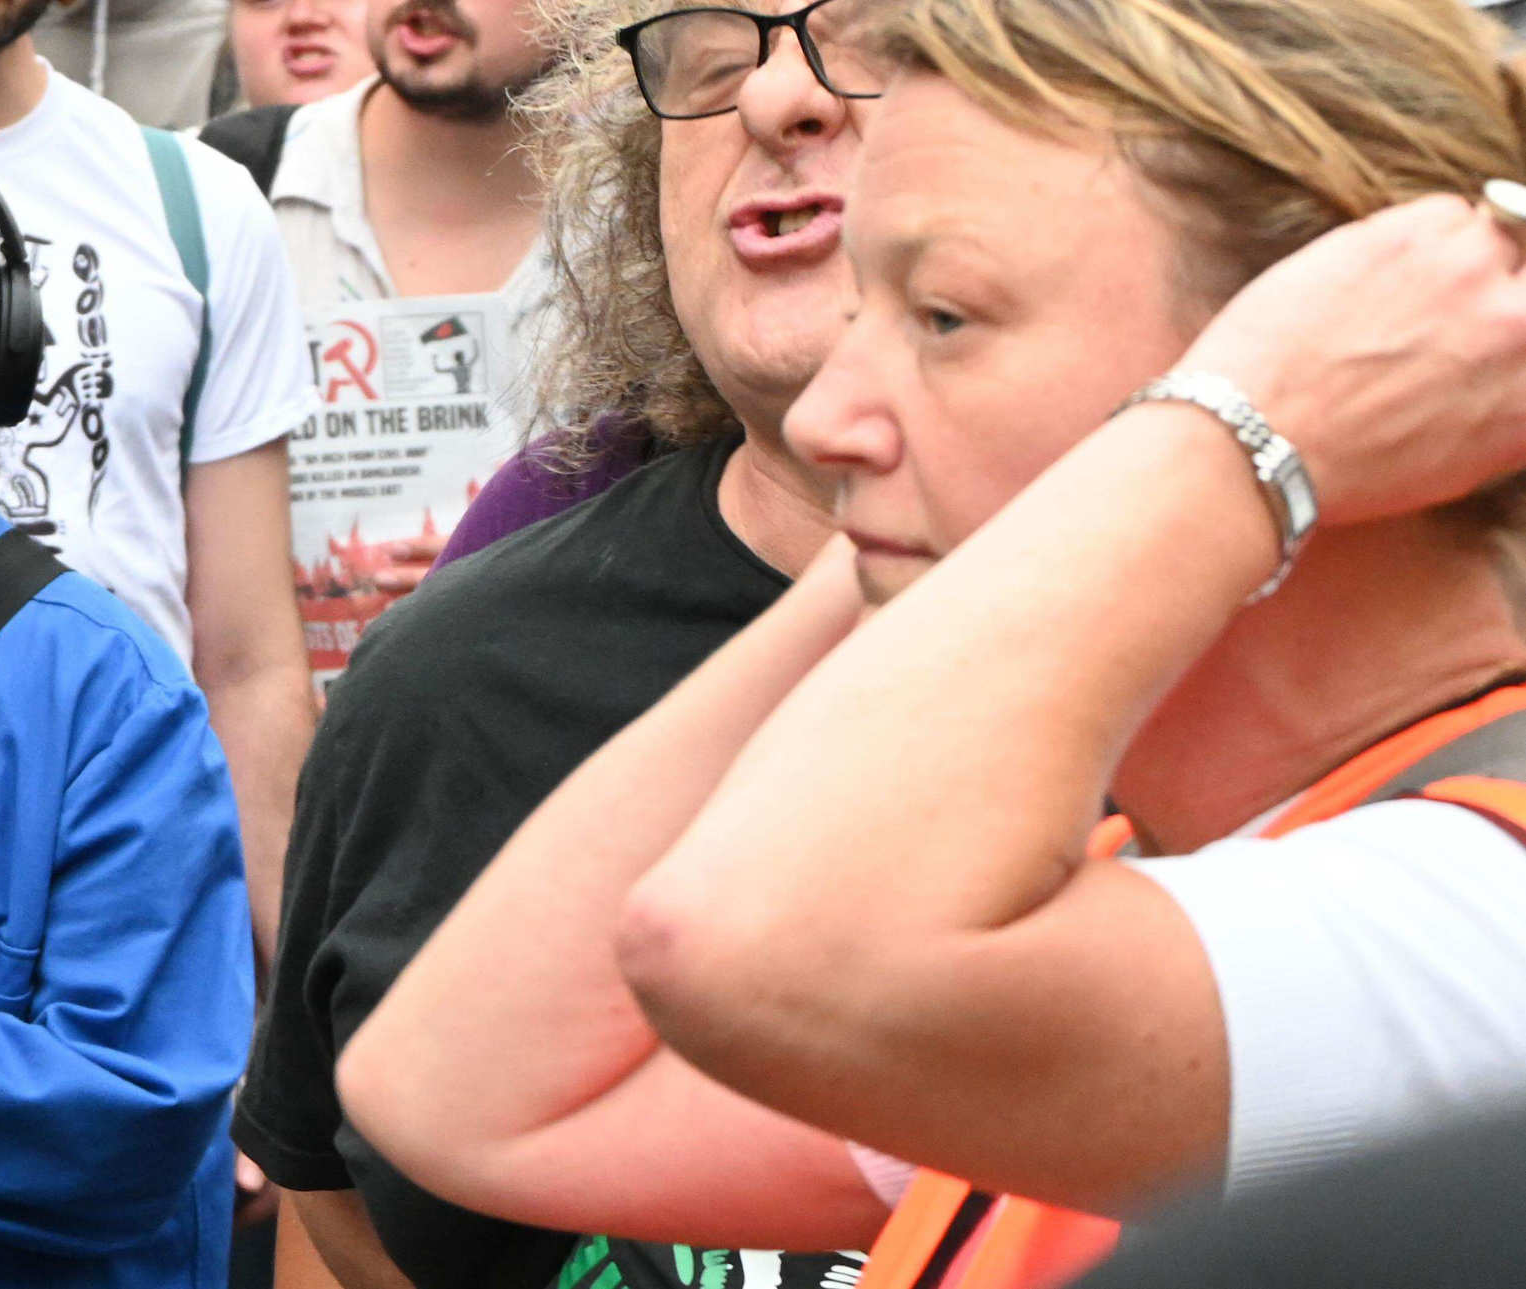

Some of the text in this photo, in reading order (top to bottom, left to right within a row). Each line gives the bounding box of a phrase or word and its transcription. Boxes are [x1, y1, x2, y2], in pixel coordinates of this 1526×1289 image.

[325, 412, 357, 438] ON
[365, 407, 409, 435] THE
[417, 402, 489, 432] BRINK
